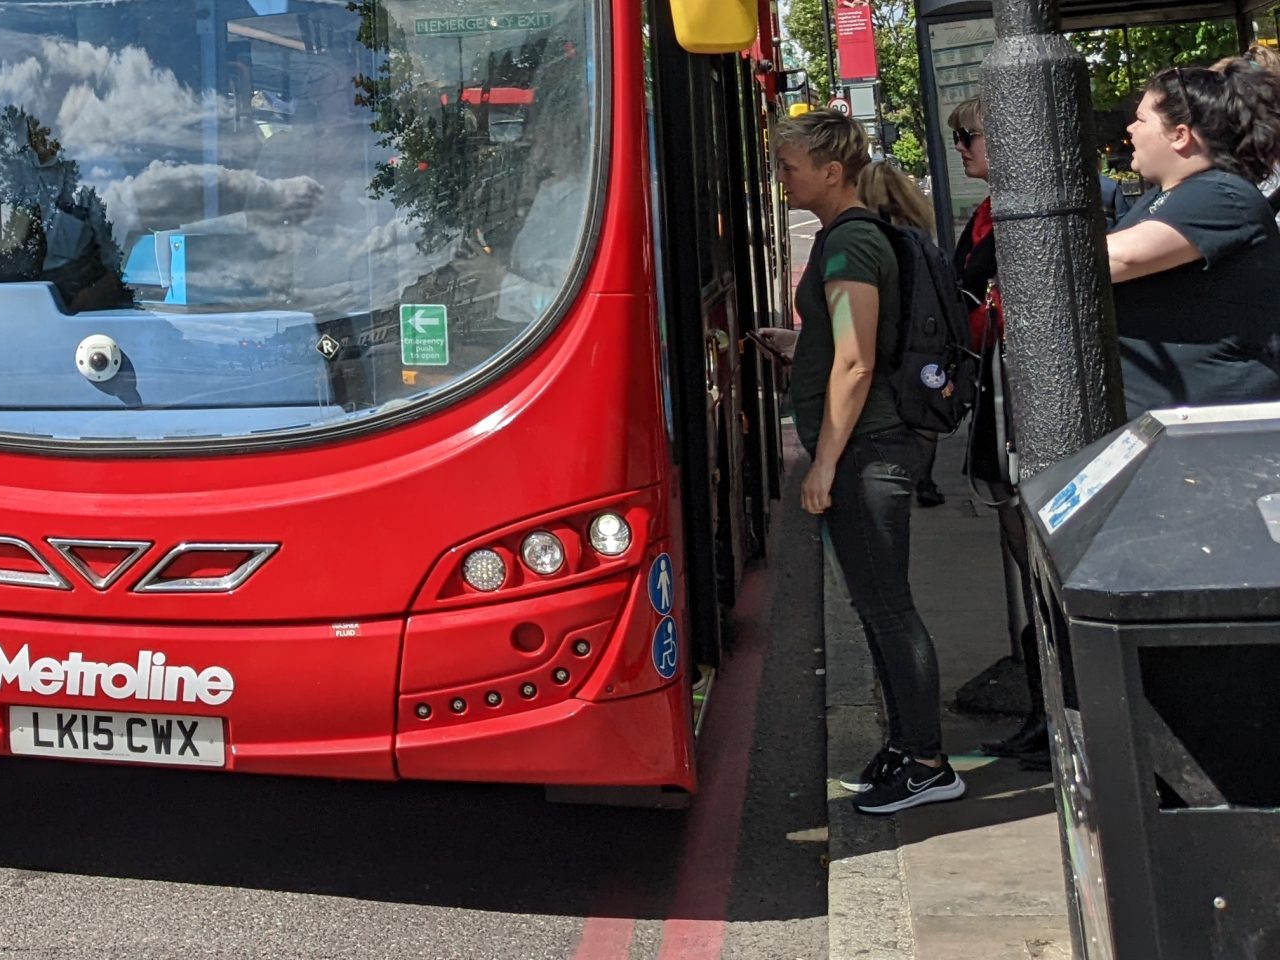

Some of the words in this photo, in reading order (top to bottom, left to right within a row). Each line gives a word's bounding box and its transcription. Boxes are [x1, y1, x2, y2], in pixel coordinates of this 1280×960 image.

[517, 14, 550, 27] EXIT
[322, 340, 333, 354] R
[335, 629, 356, 637] FLUID
[32, 711, 114, 751] LK15
[125, 717, 200, 757] CWX
